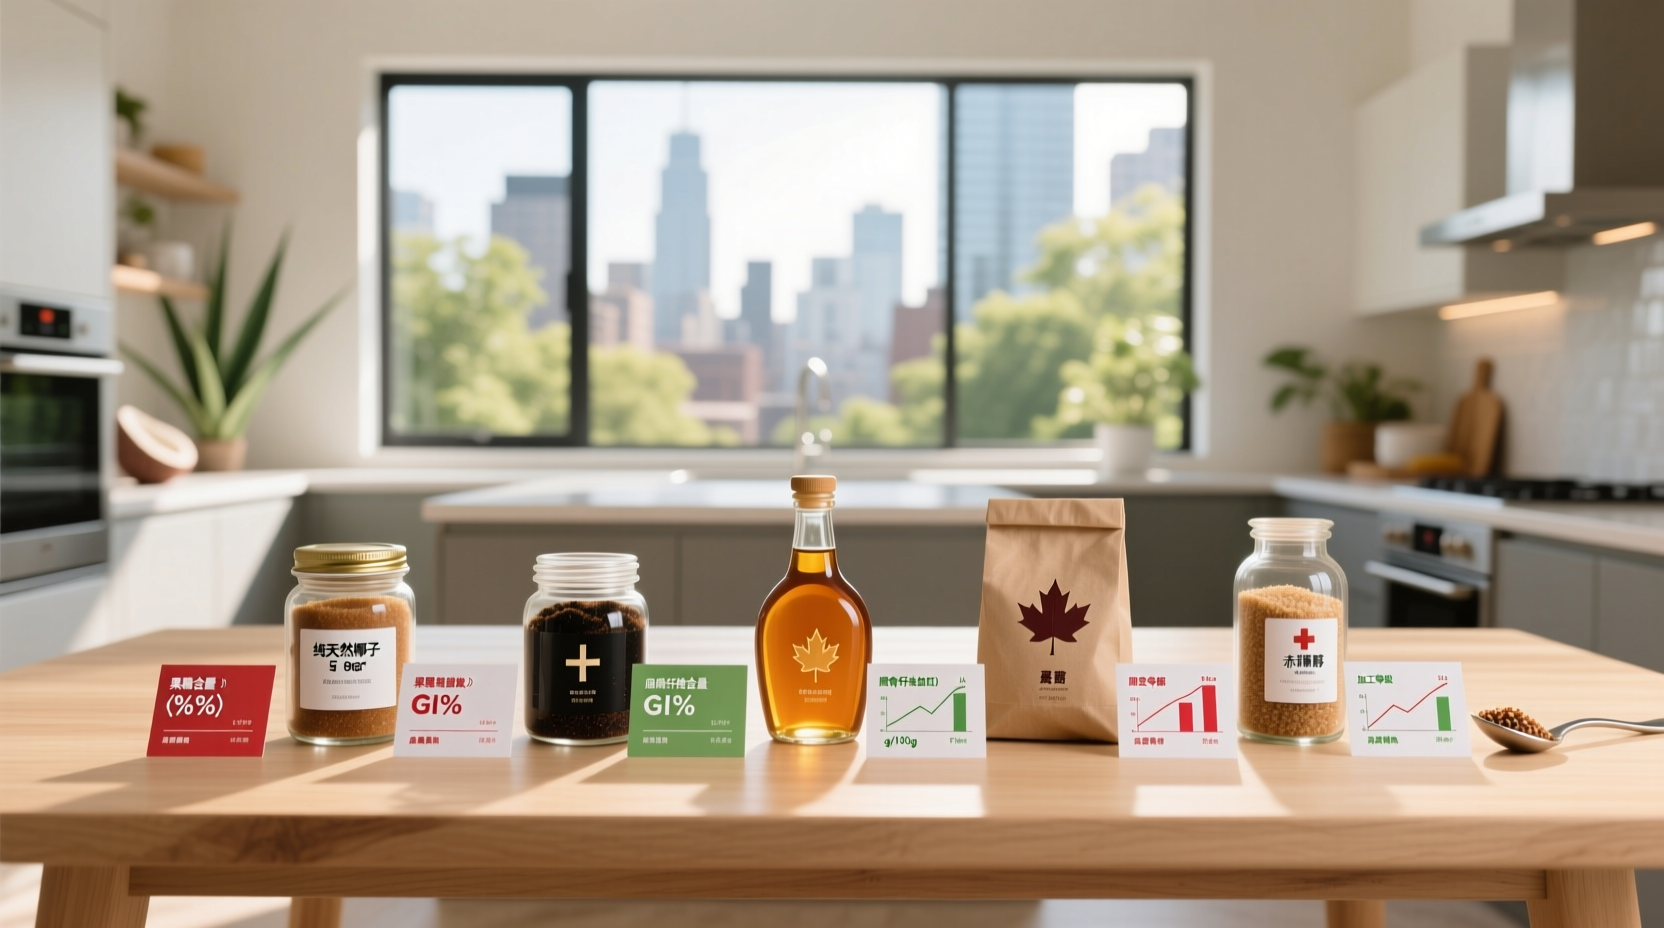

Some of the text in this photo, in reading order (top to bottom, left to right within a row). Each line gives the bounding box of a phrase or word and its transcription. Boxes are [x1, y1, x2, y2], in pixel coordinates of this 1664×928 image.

[166, 693, 223, 718] (%%)
[411, 694, 462, 715] GI%
[643, 694, 695, 716] GI%
